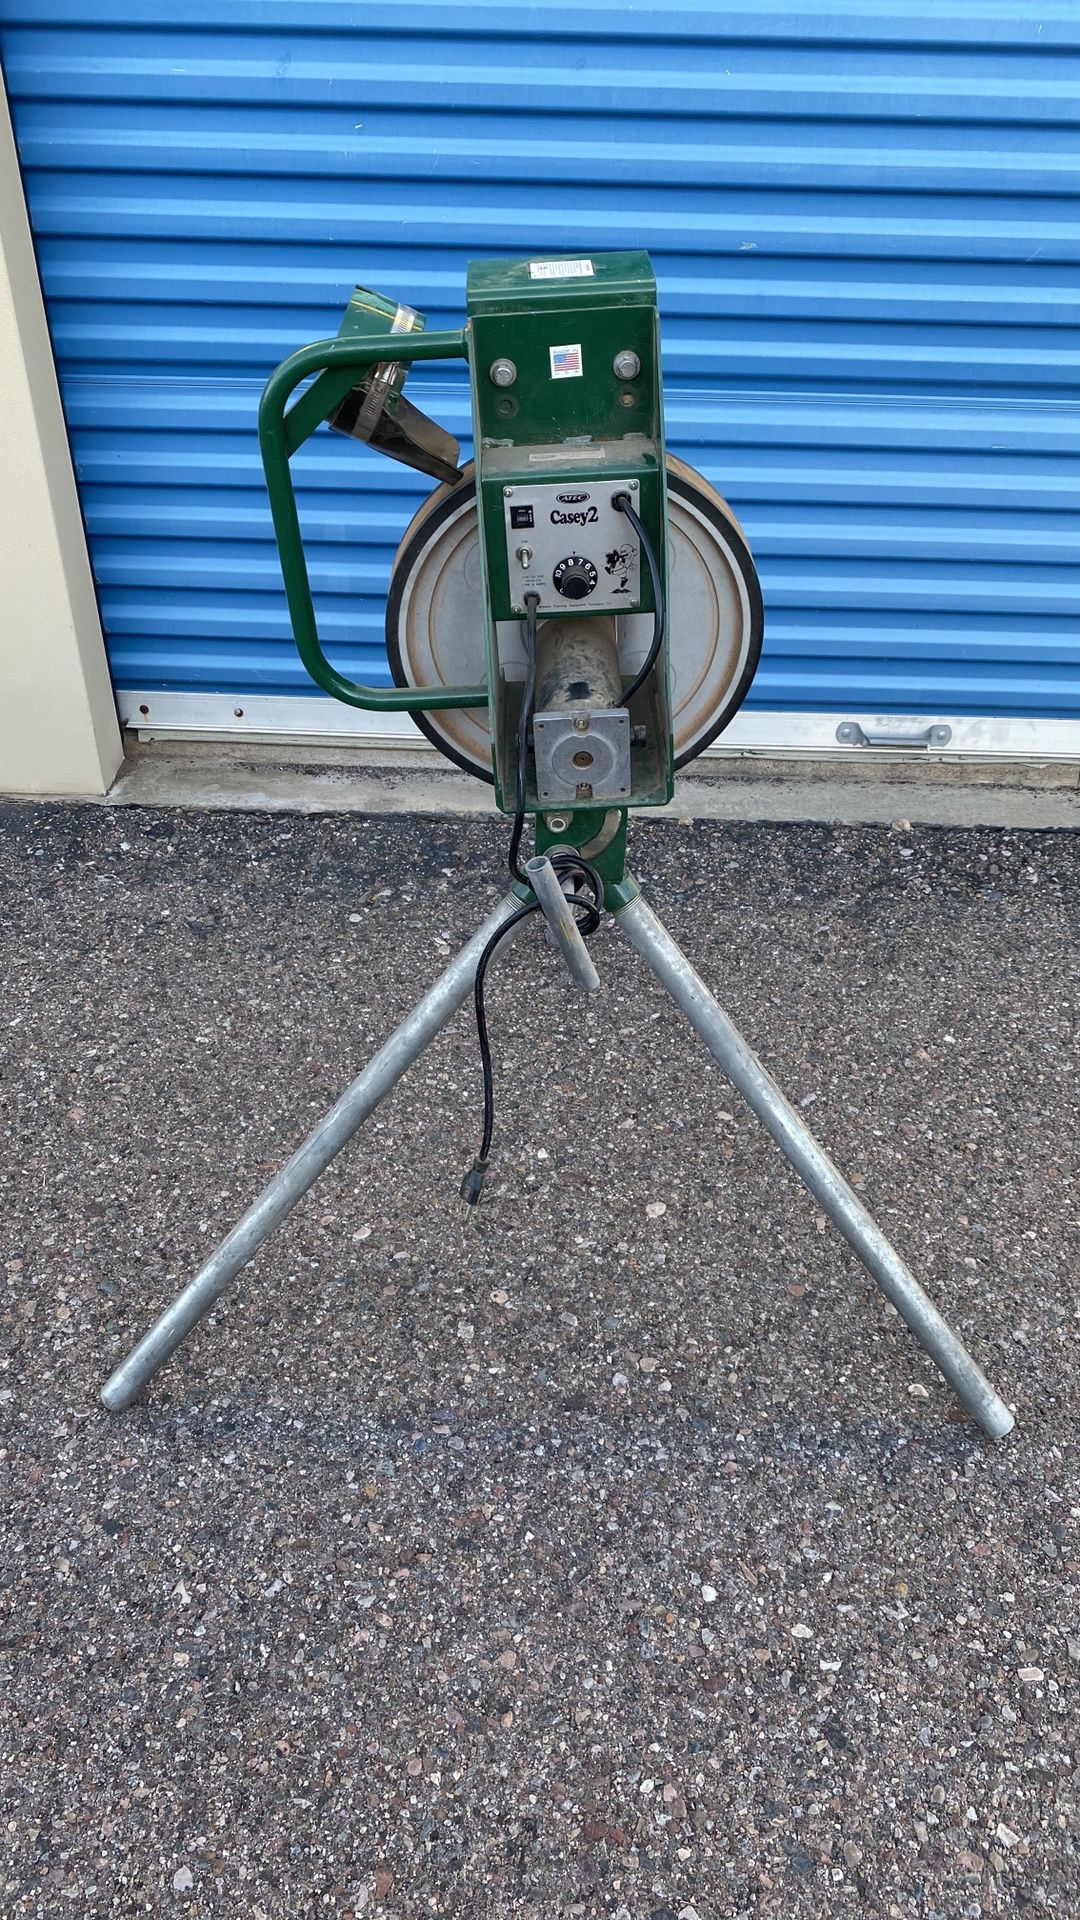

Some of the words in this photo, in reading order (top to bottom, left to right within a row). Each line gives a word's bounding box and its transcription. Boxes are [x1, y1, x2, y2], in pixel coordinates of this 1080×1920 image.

[560, 494, 587, 502] ATEC
[550, 506, 598, 526] Casey2
[555, 569, 562, 578] 10
[568, 558, 574, 566] 8
